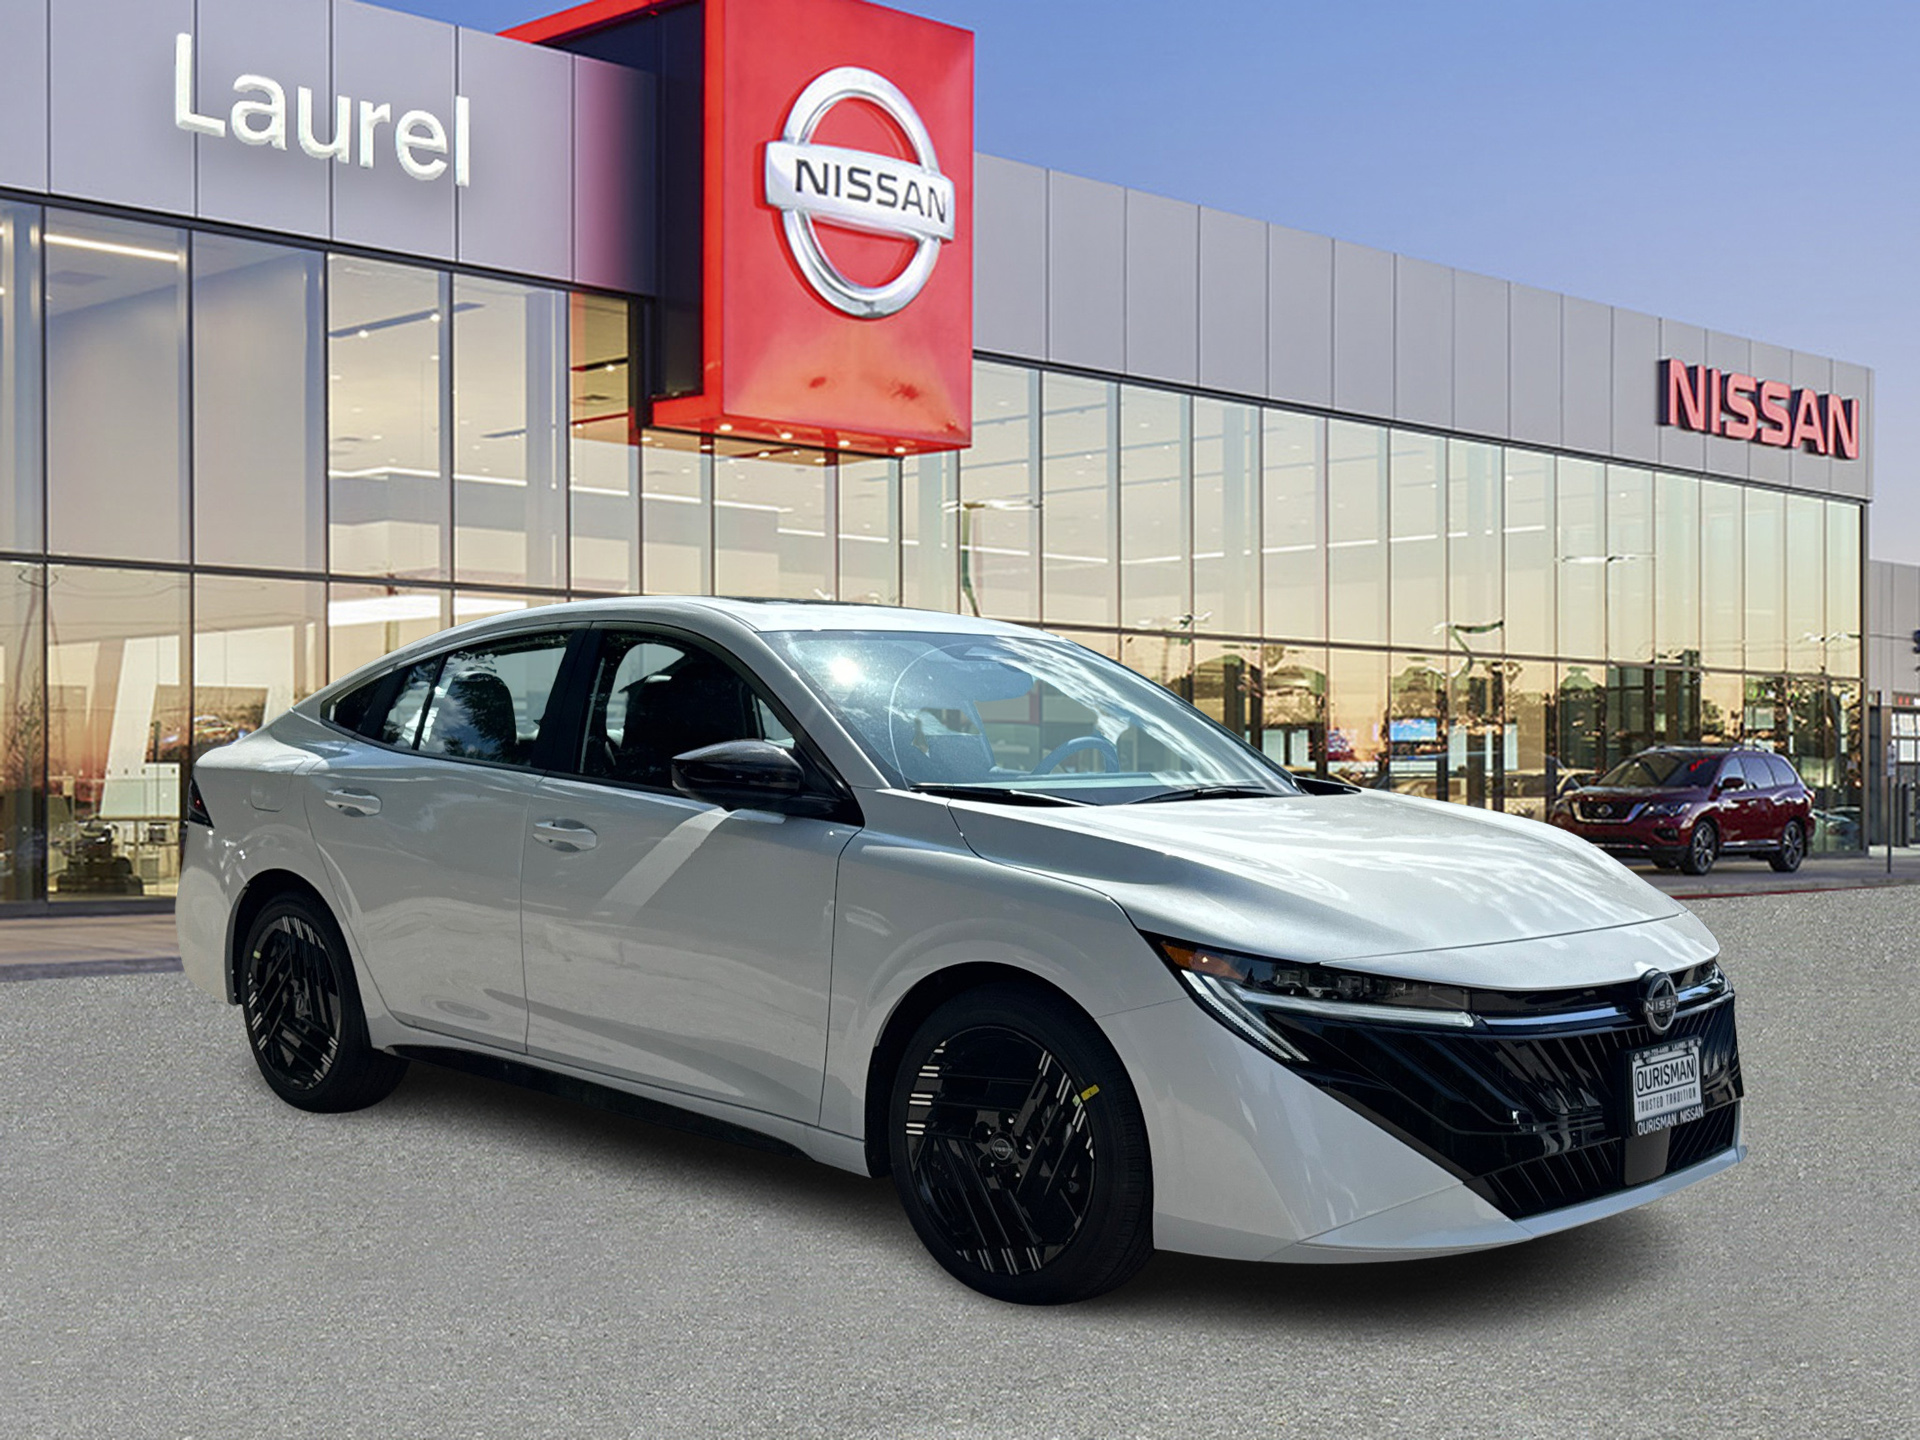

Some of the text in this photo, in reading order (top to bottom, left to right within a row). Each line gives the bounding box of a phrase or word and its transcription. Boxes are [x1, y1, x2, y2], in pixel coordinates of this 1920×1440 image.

[175, 32, 470, 188] Laurel
[795, 158, 946, 224] NISSAN
[1667, 358, 1859, 460] NISSAN
[1636, 1058, 1695, 1092] OURISMAN
[1638, 1086, 1697, 1114] TRUSTED TRADITION
[1637, 1104, 1705, 1136] OURISMAN NISSAN
